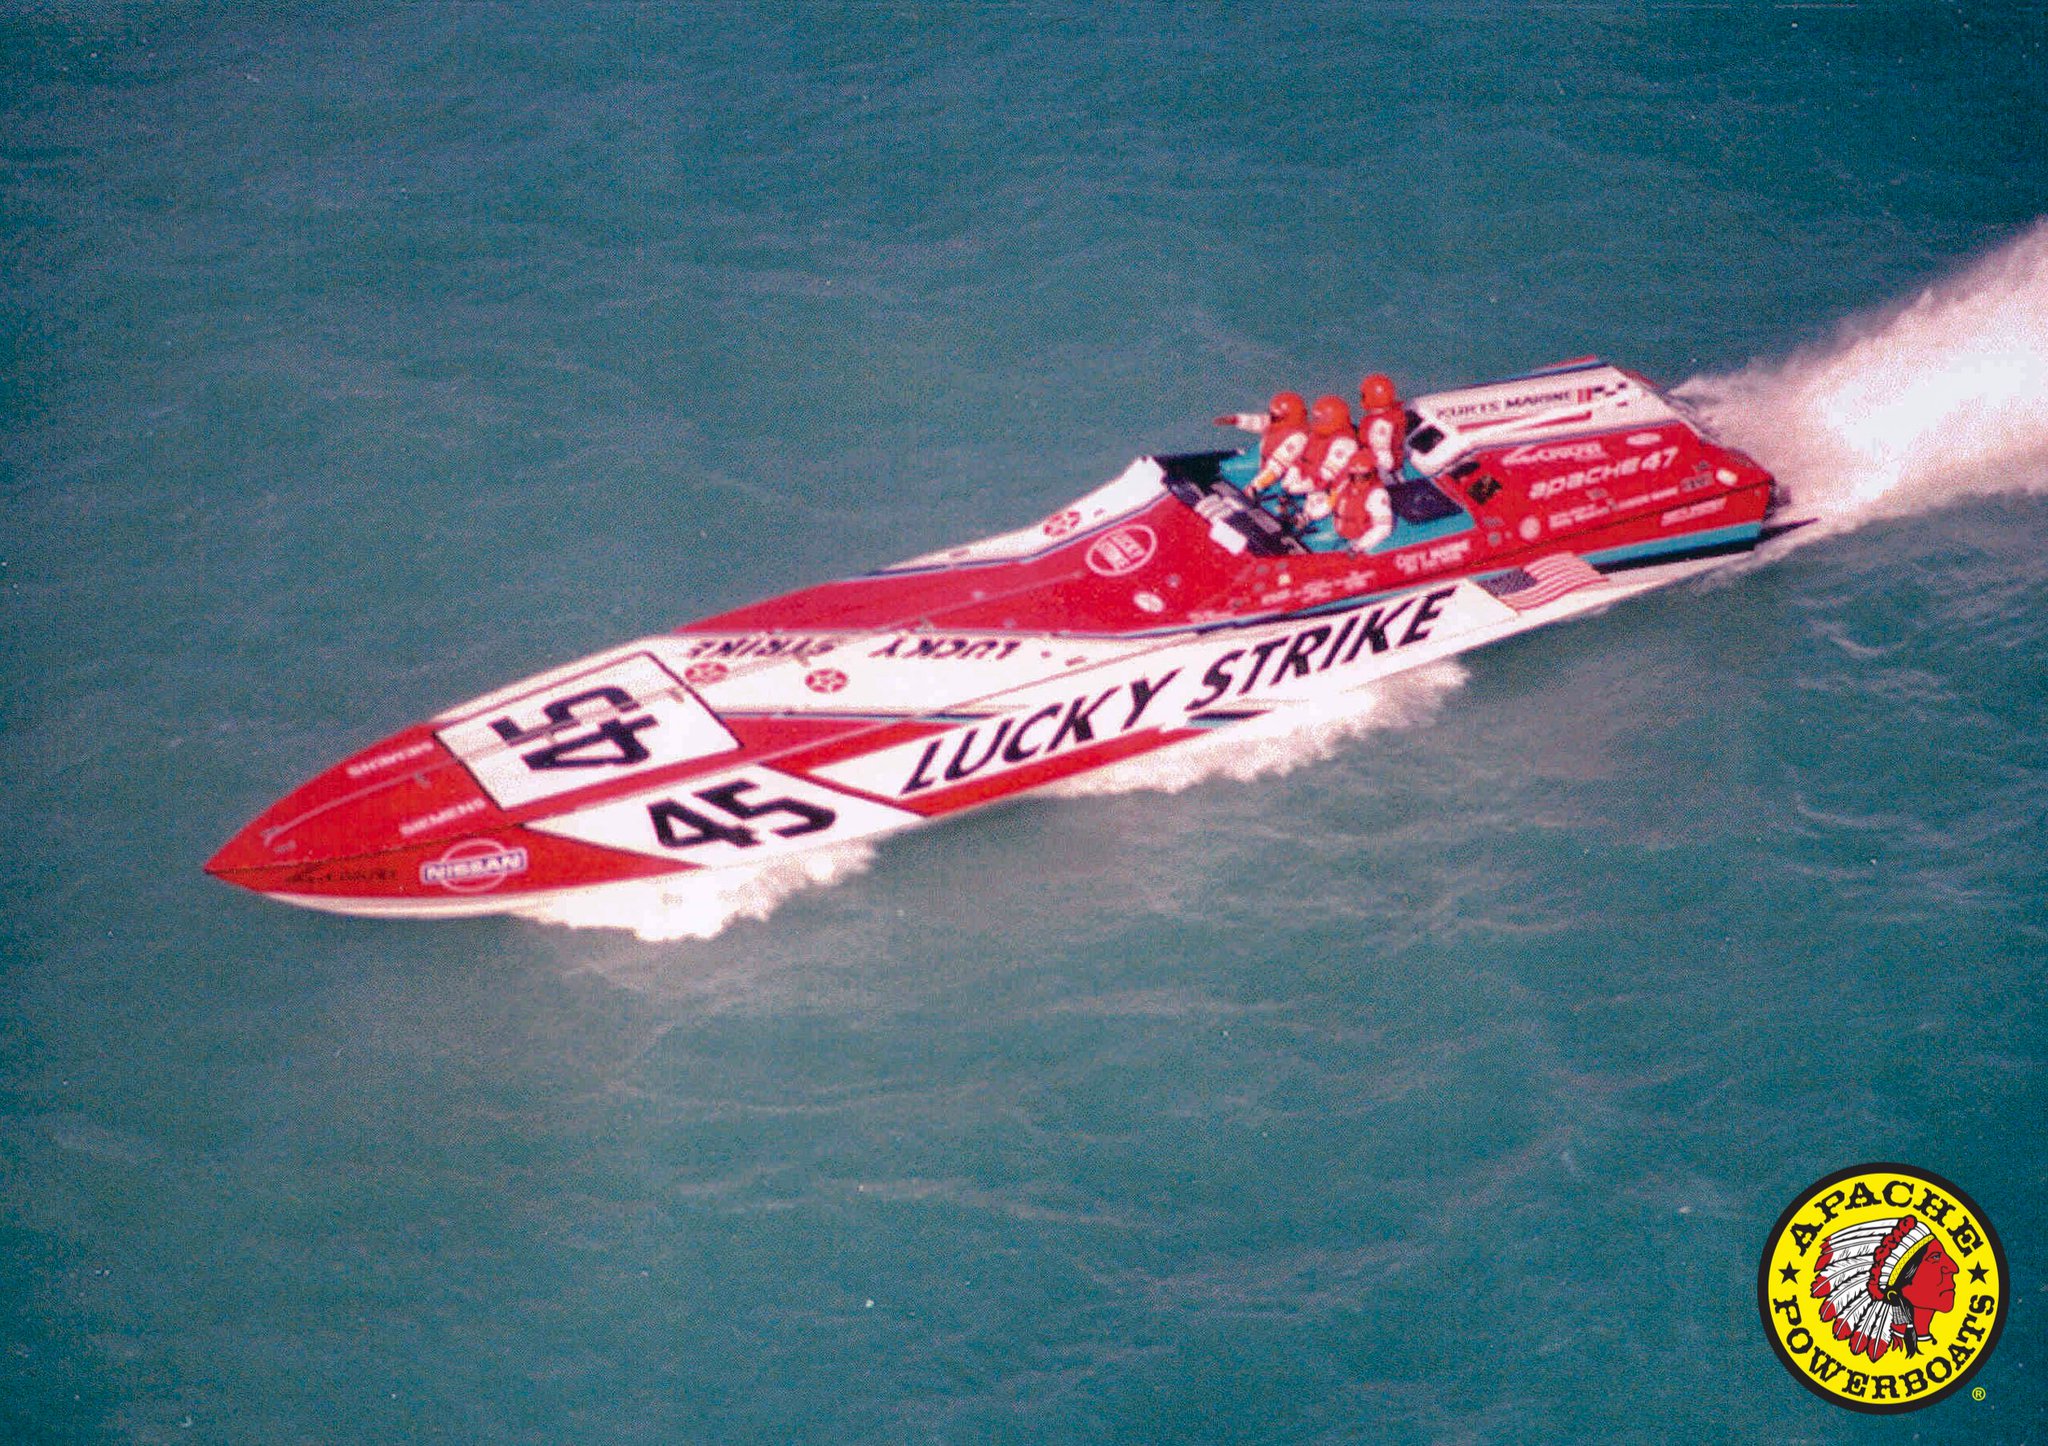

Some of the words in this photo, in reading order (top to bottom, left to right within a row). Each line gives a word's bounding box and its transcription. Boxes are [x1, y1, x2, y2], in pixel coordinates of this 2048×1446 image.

[1640, 445, 1680, 472] 47
[869, 637, 1021, 659] LUCKY
[901, 667, 1186, 795] LUCKY
[1184, 587, 1457, 711] STRIKE
[488, 687, 659, 771] 45
[647, 779, 837, 849] 45
[423, 850, 526, 883] NISSAN
